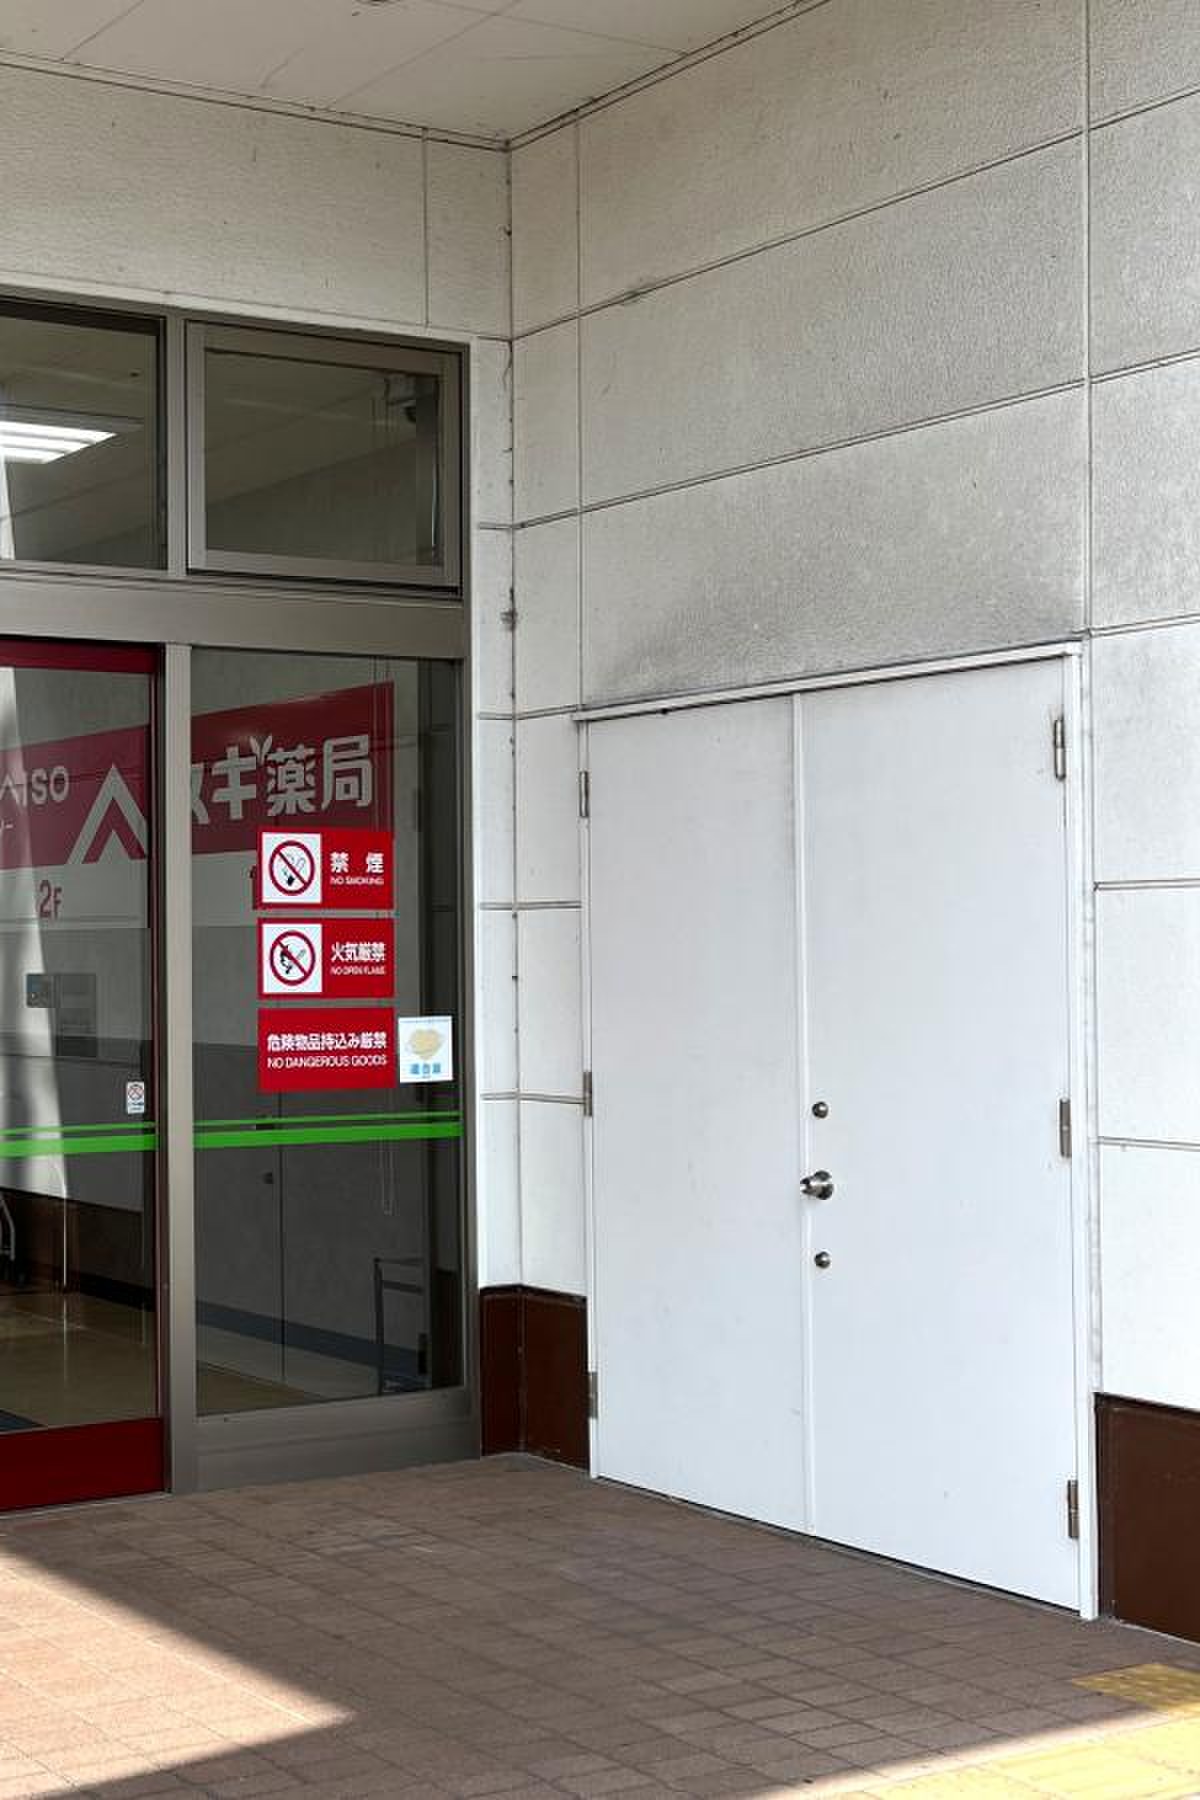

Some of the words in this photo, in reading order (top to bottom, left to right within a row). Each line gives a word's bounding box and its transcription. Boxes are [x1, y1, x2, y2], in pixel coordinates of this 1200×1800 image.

[330, 876, 344, 885] NO
[346, 876, 385, 886] SMOKING
[38, 879, 63, 919] 2F
[331, 942, 386, 962] 火気厳禁
[267, 1056, 283, 1069] NO
[285, 1055, 349, 1068] DANGEROUS
[351, 1054, 387, 1067] GOODS
